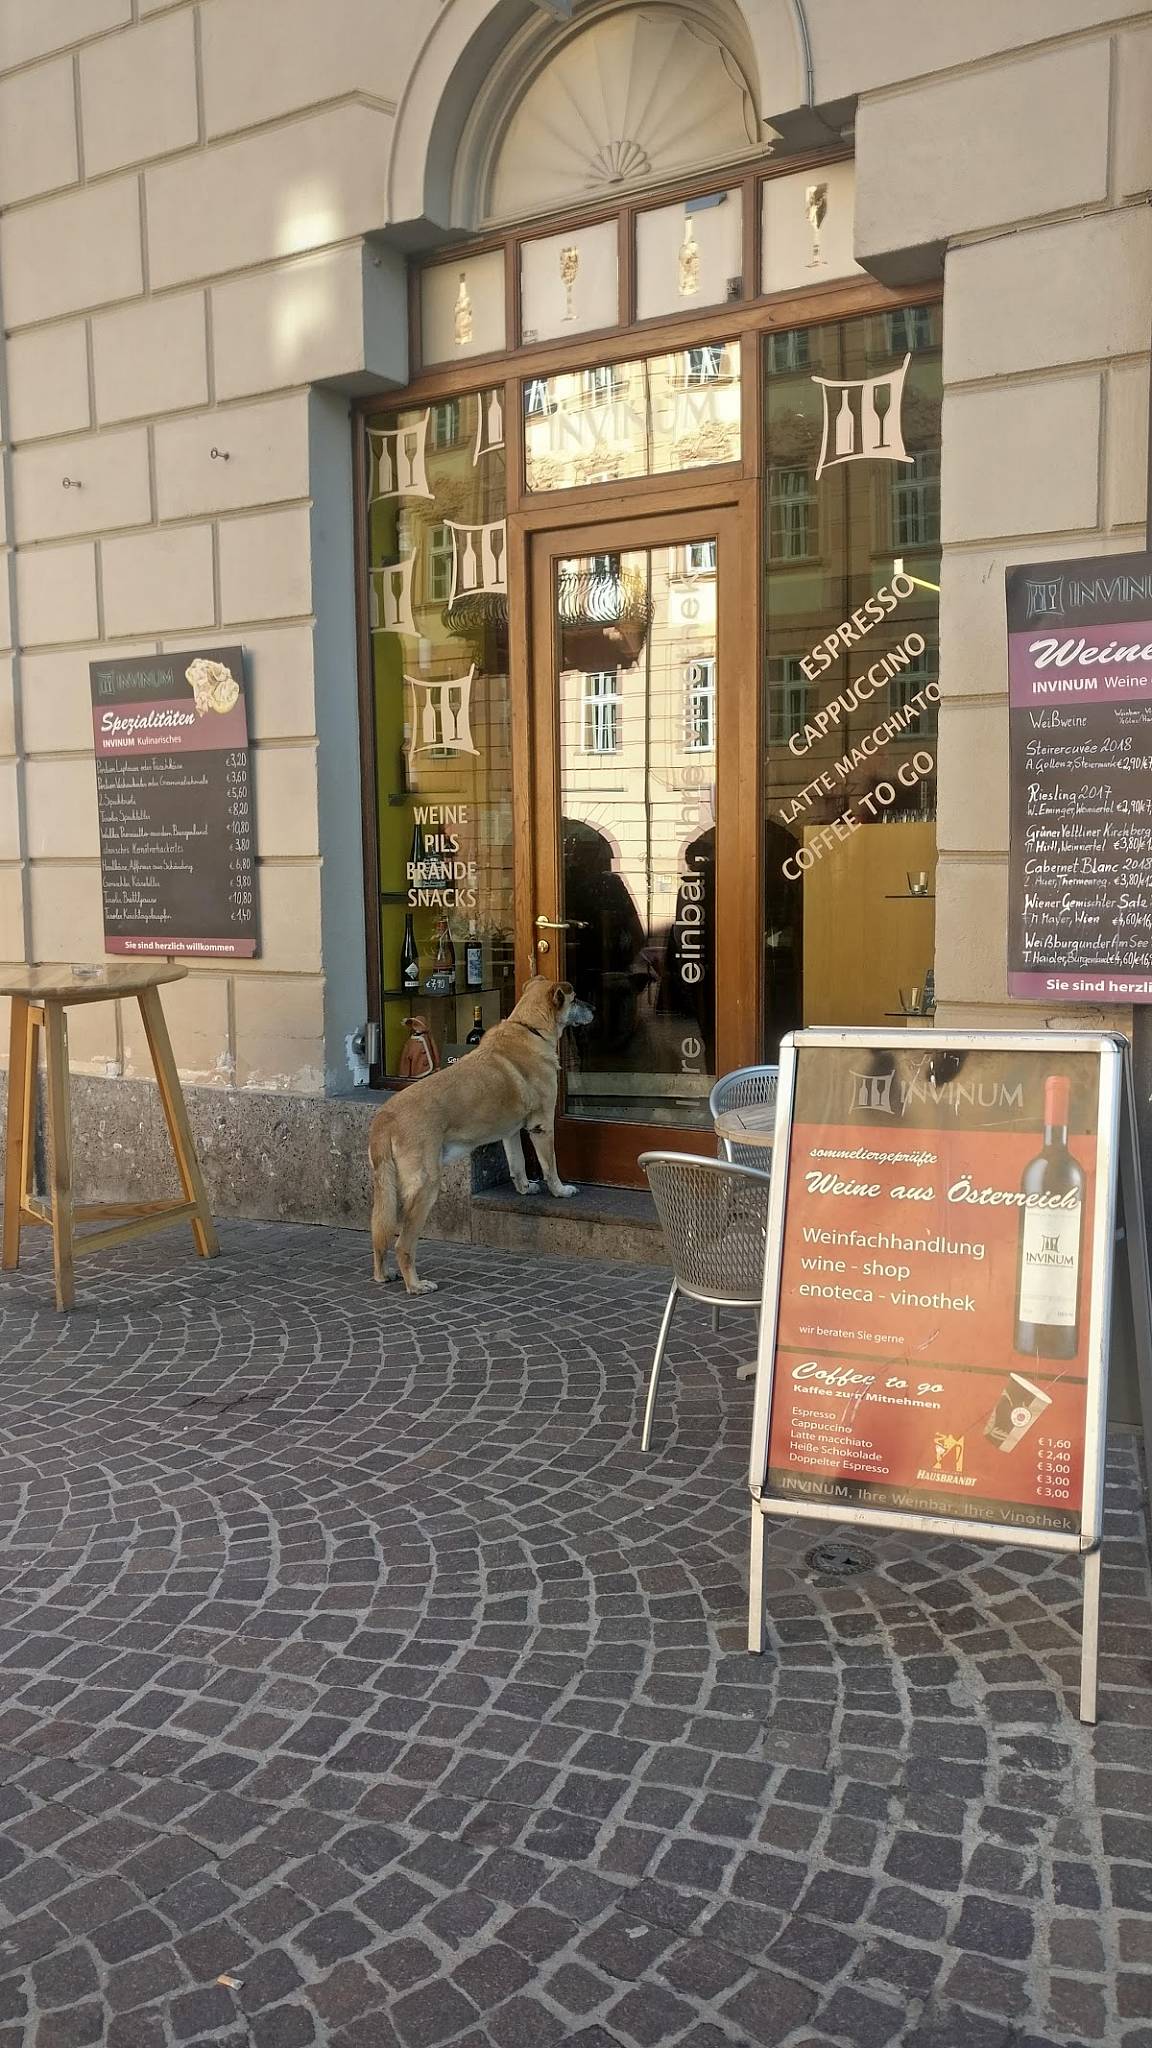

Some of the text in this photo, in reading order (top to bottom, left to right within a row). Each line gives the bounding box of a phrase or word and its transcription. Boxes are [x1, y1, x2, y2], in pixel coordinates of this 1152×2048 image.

[550, 385, 716, 451] INVINUM
[799, 572, 914, 681] ESPRESSO
[1029, 638, 1152, 669] Weine
[116, 667, 175, 689] INVINUM
[1032, 677, 1098, 693] INVINUM
[1104, 675, 1148, 689] Weine
[788, 632, 926, 757] CAPPUCCINO
[101, 710, 195, 735] Spezialitäten
[103, 735, 182, 748] INVINUM Kulinarisches
[1100, 737, 1133, 752] 2018
[779, 681, 940, 825] LATTE MACCHIATO
[1027, 782, 1112, 806] Riesling 2017
[413, 805, 468, 824] WEINE
[782, 750, 934, 881] COFFEE TO GO
[424, 833, 460, 853] PILS
[1024, 857, 1080, 874] Cabernet
[1080, 856, 1120, 873] Blanc
[408, 888, 477, 907] SNACKS
[1024, 893, 1061, 915] Wiener
[125, 941, 234, 952] Sie sind herzlich willkommen
[1047, 979, 1069, 990] Sie
[1072, 980, 1105, 992] sind
[901, 1080, 1023, 1107] INVINUM
[809, 1146, 938, 1168] sommeliergeprüfte
[805, 1170, 1079, 1210] Weine aus Österreich
[803, 1227, 985, 1260] Weinfachhandlung
[800, 1255, 846, 1272] wine
[863, 1260, 910, 1281] shop
[1026, 1252, 1074, 1265] INVINUM
[799, 1282, 873, 1302] enoteca
[890, 1289, 975, 1311] vinothek
[799, 1325, 904, 1344] wir beraten Sie gerne
[792, 1361, 945, 1396] Coffee to go
[793, 1384, 941, 1409] Kaffee zum Mitnehmen
[792, 1406, 836, 1420] Espresso
[791, 1418, 852, 1434] Cappuccino
[791, 1429, 873, 1449] Latte macchiato
[1048, 1438, 1071, 1450] 1,60
[790, 1441, 882, 1461] Heiße Schokolade
[1046, 1451, 1070, 1462] 2,40
[789, 1453, 889, 1475] Doppelter Espresso
[1046, 1463, 1070, 1474] 3,00
[1046, 1476, 1070, 1487] 3,00
[782, 1477, 1072, 1530] INVINUM, Ihre Weinbar, Ihre Vinothek
[1045, 1488, 1070, 1499] 3,00
